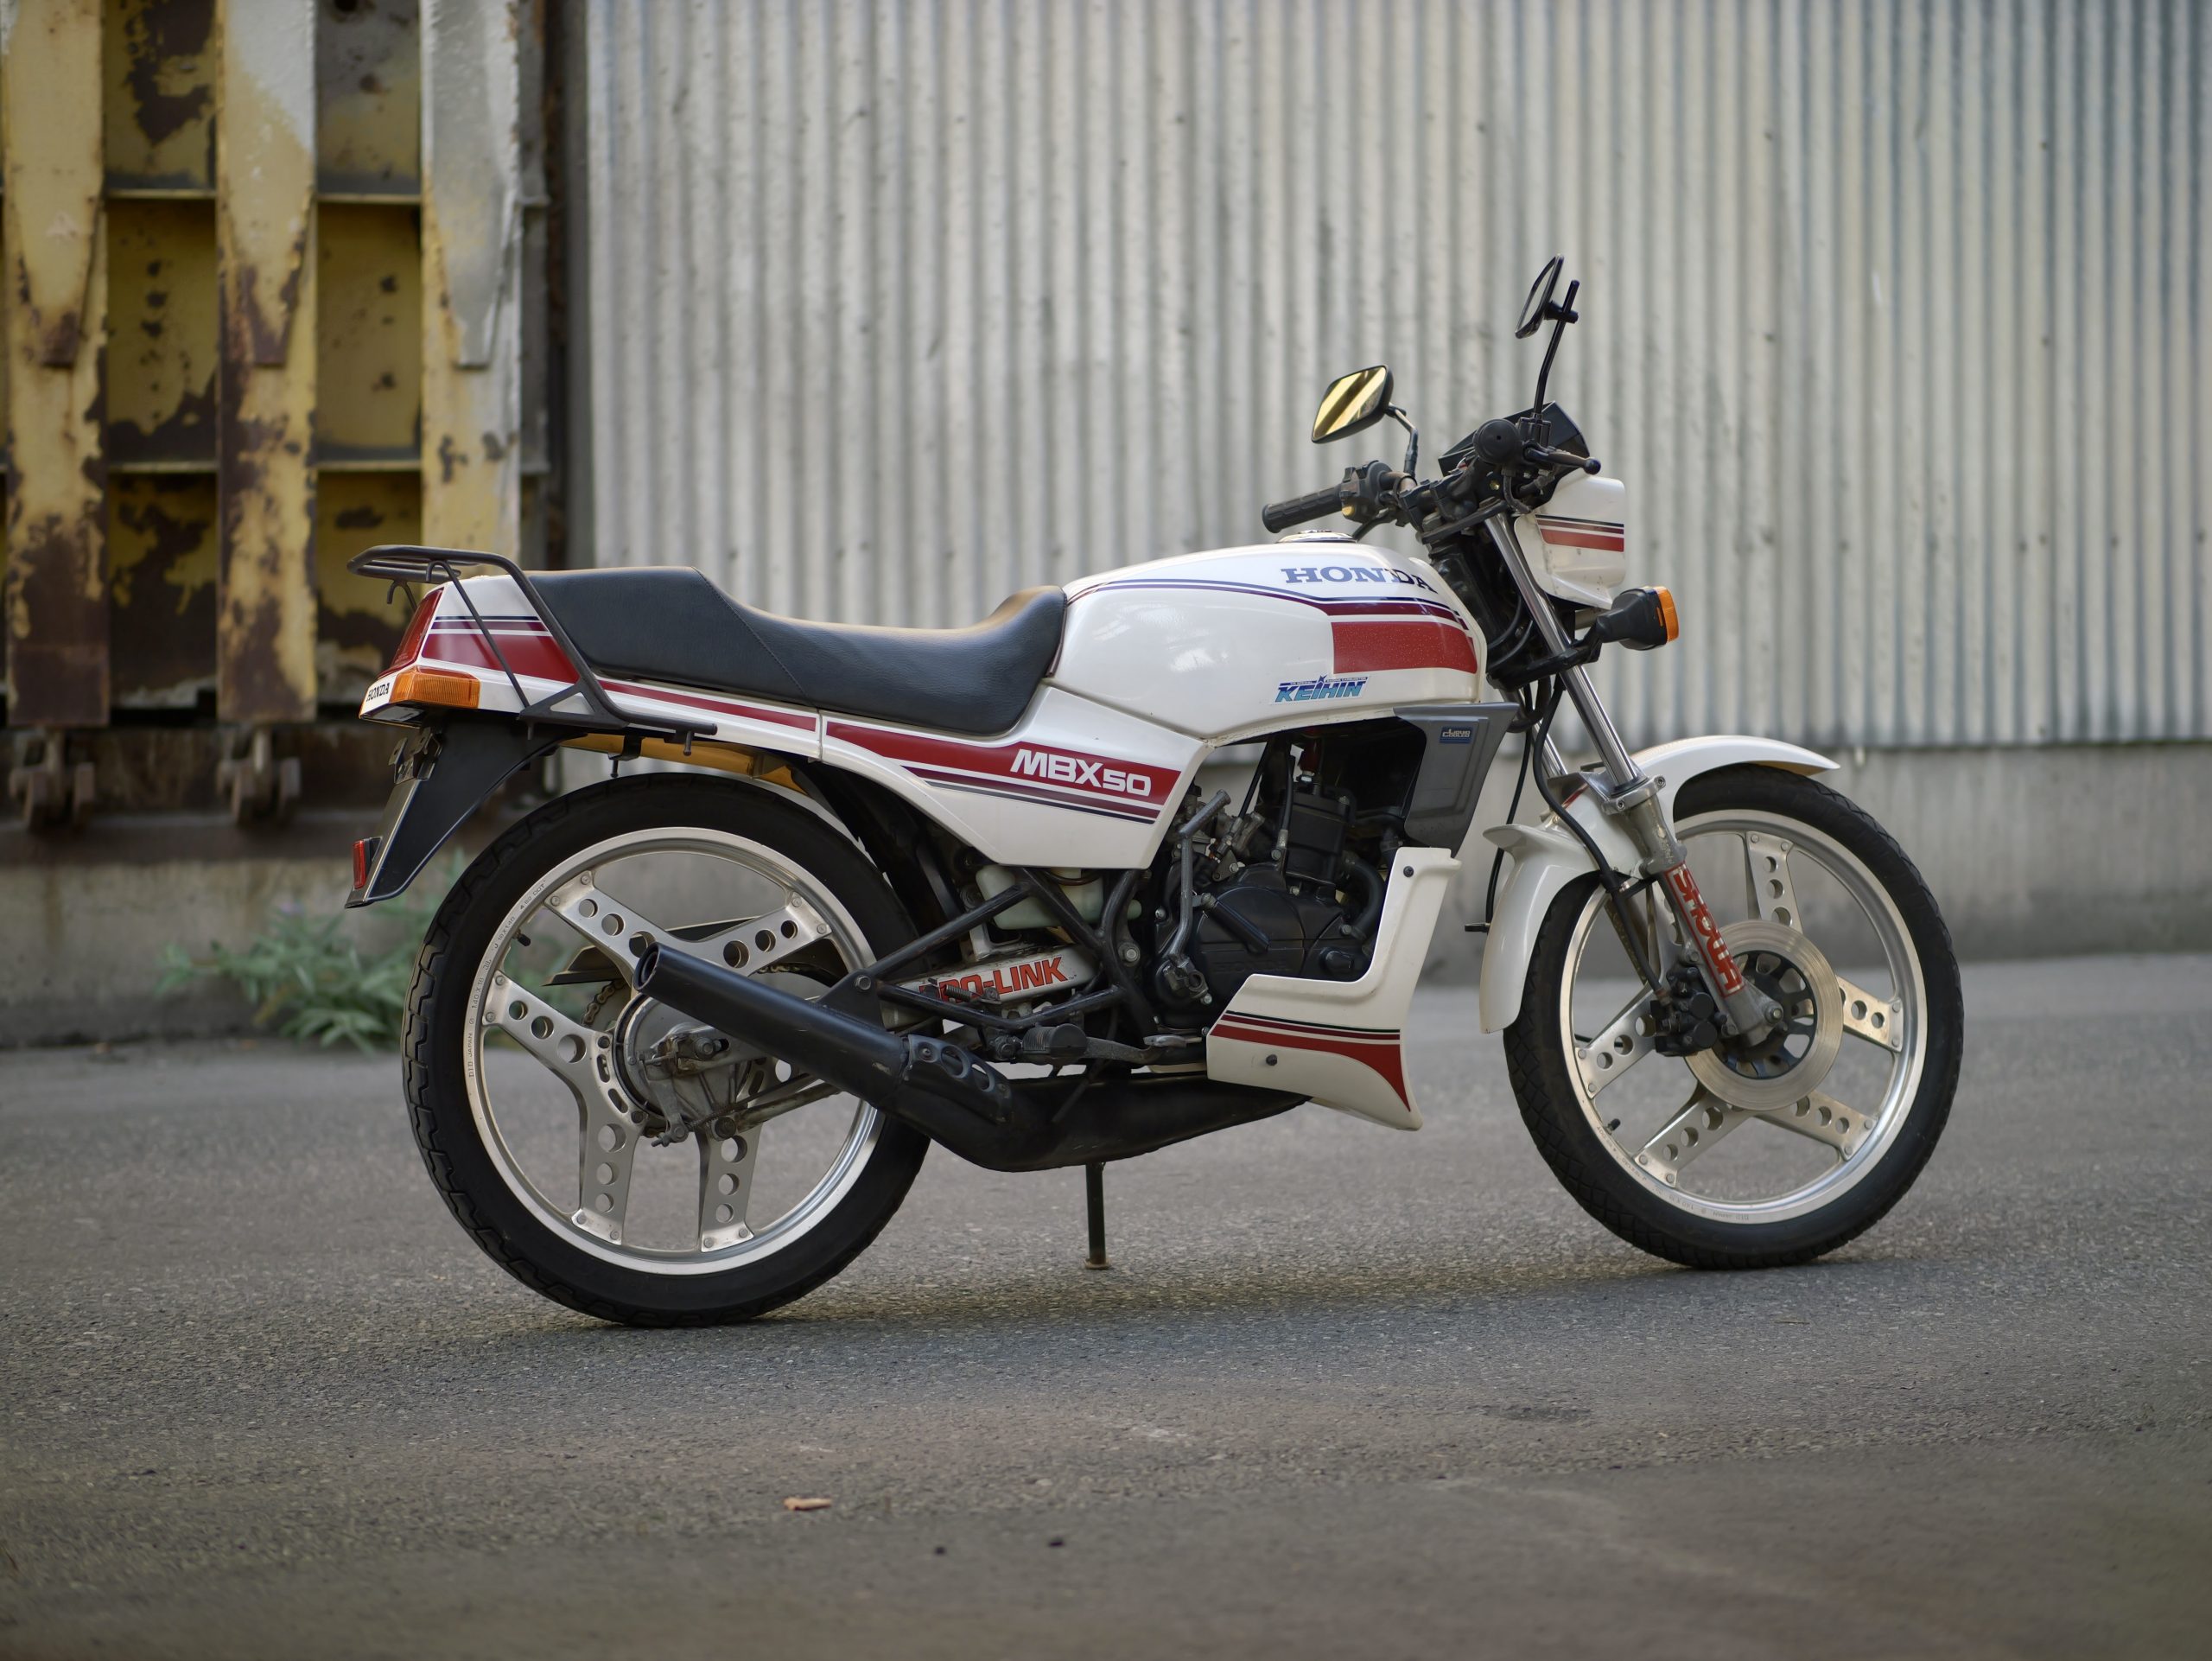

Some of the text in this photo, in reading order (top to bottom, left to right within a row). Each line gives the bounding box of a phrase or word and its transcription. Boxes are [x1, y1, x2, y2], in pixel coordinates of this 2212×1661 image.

[1281, 566, 1439, 595] HONDA
[366, 682, 391, 702] HONDA
[1275, 678, 1367, 703] KEIHIN
[1010, 748, 1152, 797] MBX50
[1673, 869, 1743, 990] SHOWA
[919, 957, 1068, 1004] RO-LINK
